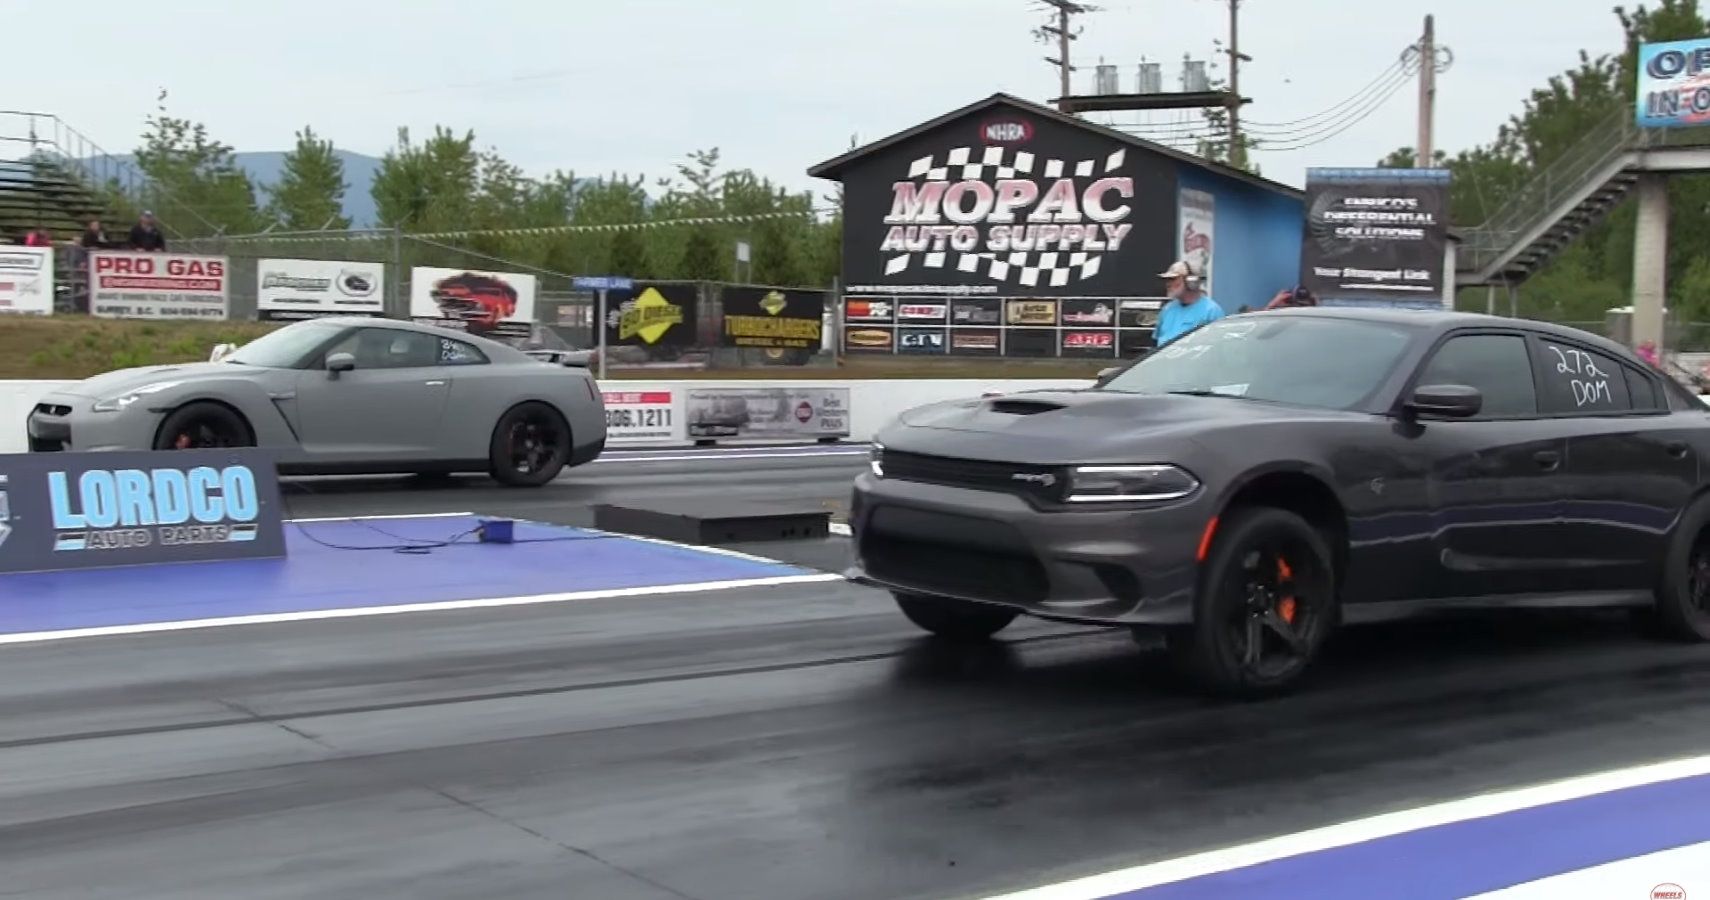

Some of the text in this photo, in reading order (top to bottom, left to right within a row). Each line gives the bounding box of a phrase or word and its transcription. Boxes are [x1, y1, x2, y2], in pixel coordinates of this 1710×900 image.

[986, 122, 1025, 141] NHRA
[883, 177, 1135, 224] MOPAC
[880, 223, 1133, 252] AUTO SUPPLY
[95, 256, 224, 277] PRO GAS
[1549, 346, 1609, 378] 272
[1571, 379, 1612, 407] DOM
[48, 465, 259, 529] LORDCO
[87, 525, 229, 549] AUTO PARTS
